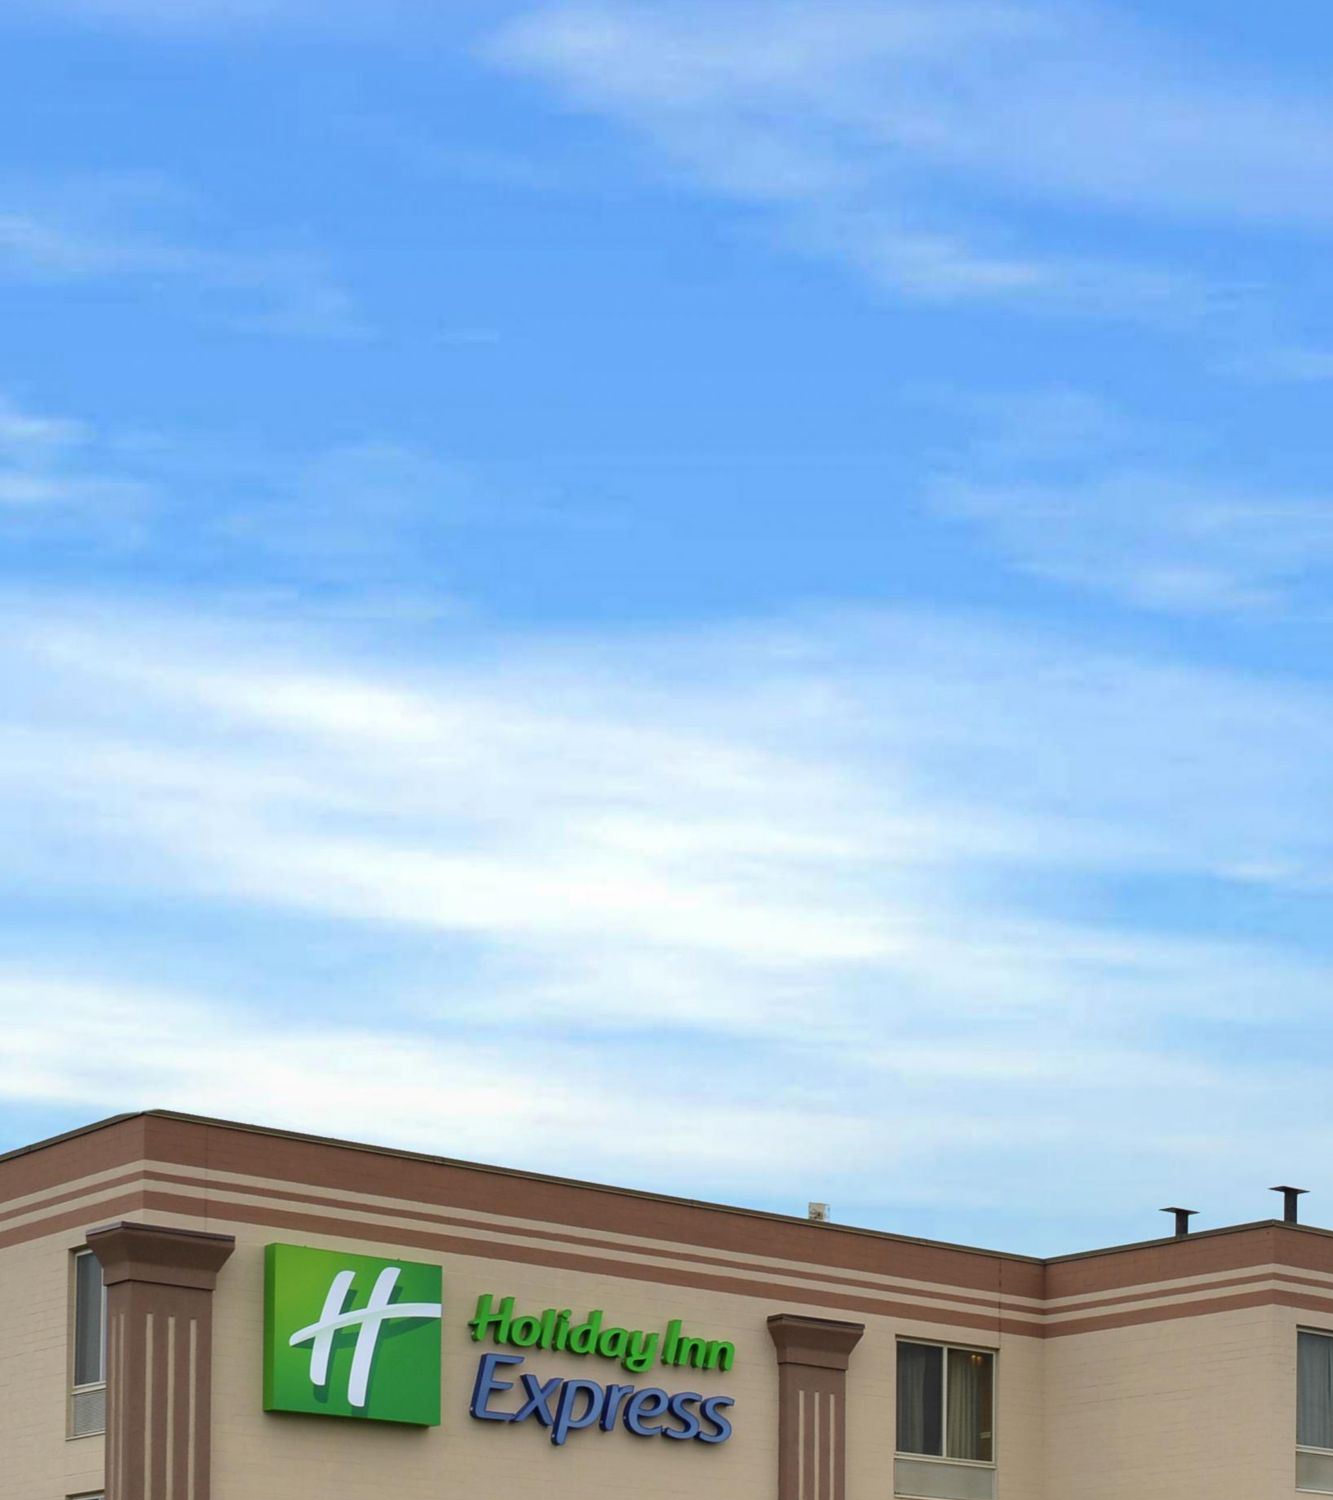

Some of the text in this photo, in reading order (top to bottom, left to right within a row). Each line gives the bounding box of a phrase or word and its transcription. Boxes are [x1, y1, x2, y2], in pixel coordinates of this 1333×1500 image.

[468, 1293, 735, 1373] Holiday Inn
[469, 1353, 735, 1446] Express
